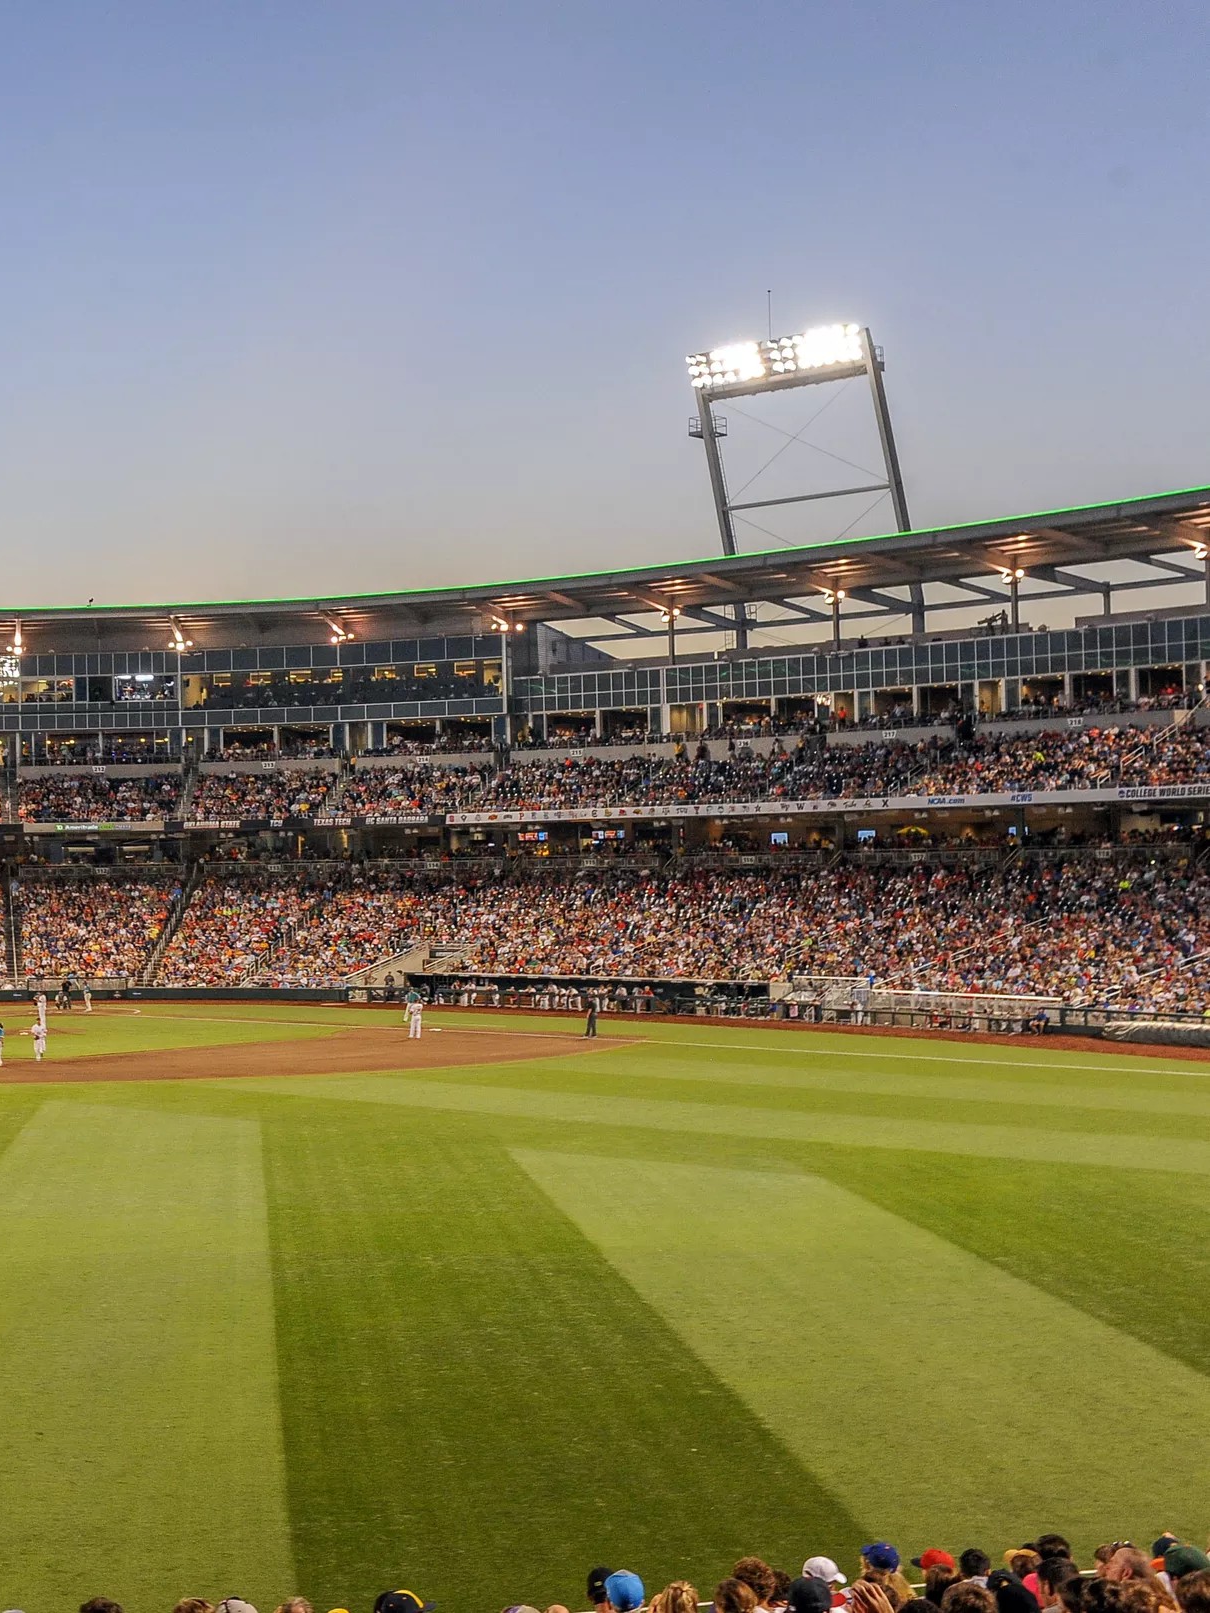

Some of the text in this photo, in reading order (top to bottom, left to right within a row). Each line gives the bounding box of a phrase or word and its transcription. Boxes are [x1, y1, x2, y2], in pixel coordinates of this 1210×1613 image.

[1126, 788, 1157, 798] COLLEGE
[1159, 787, 1186, 797] WORLD
[927, 797, 965, 805] NCAA.com
[1010, 793, 1033, 802] #CWS
[183, 820, 240, 829] OKLAHOMA STATE
[270, 819, 283, 827] TCU
[313, 818, 352, 826] TEXAS TECH
[365, 815, 428, 825] UC SANTA BARBARA
